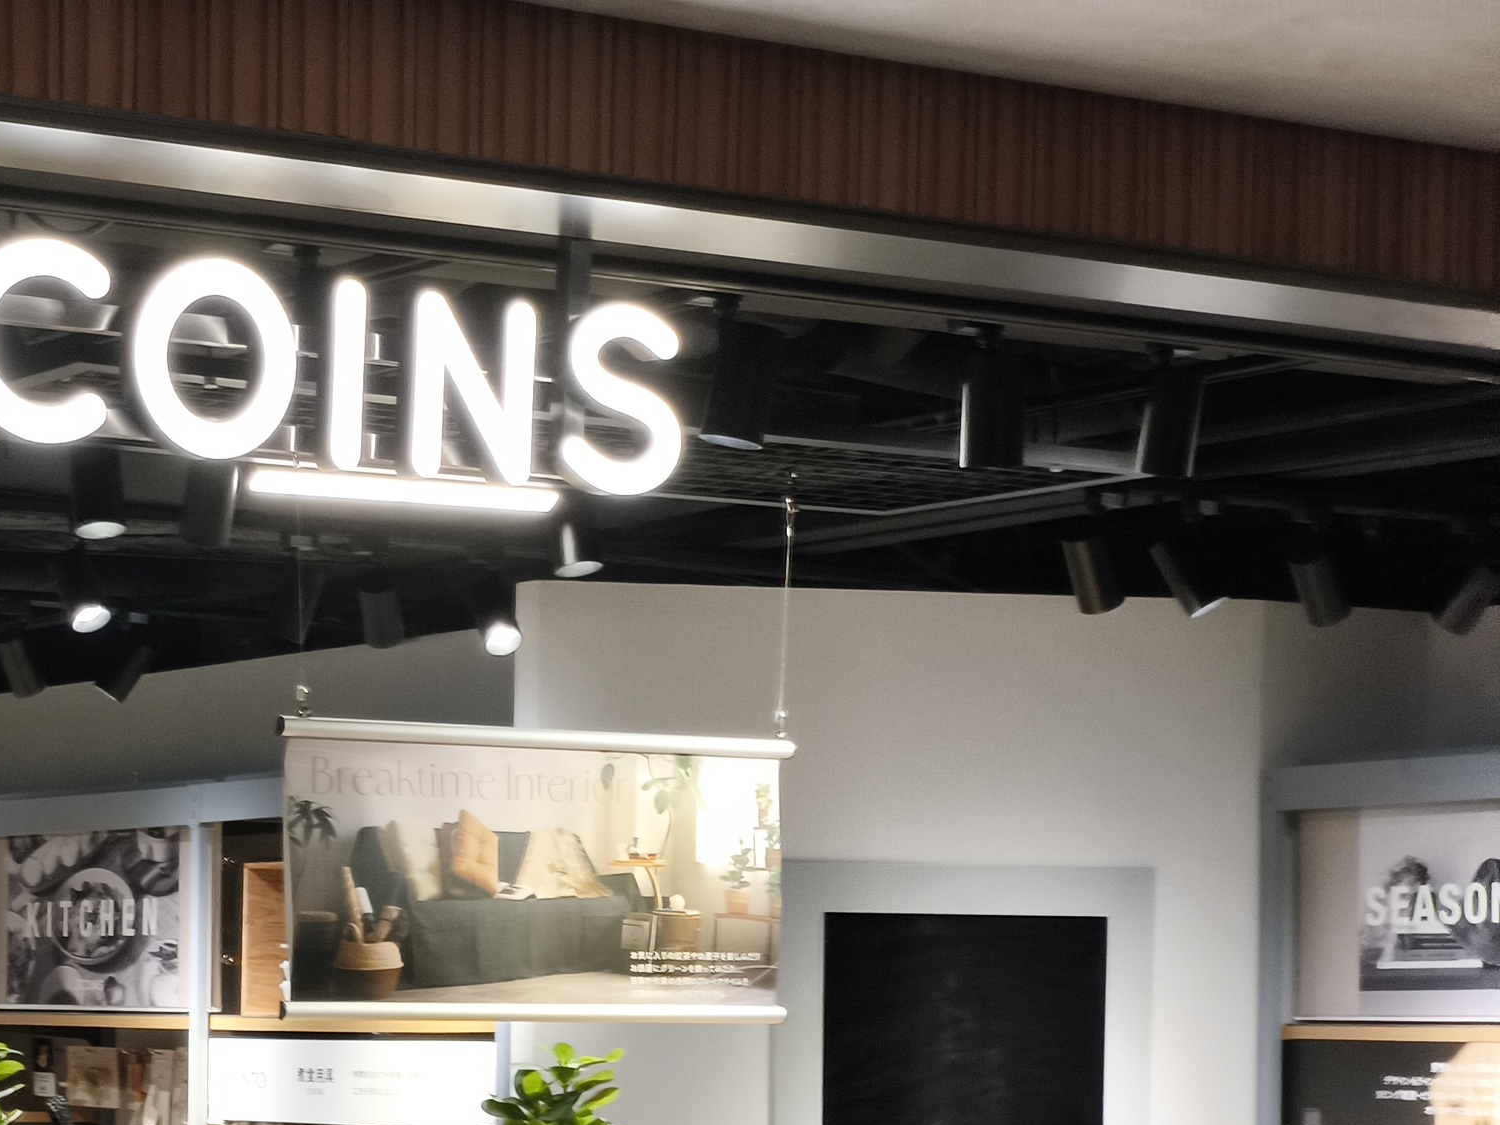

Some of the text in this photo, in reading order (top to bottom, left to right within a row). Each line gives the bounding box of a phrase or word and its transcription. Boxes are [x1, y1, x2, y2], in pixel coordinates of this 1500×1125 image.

[310, 756, 632, 804] Breaktime Interior
[25, 898, 159, 938] KITCHEN
